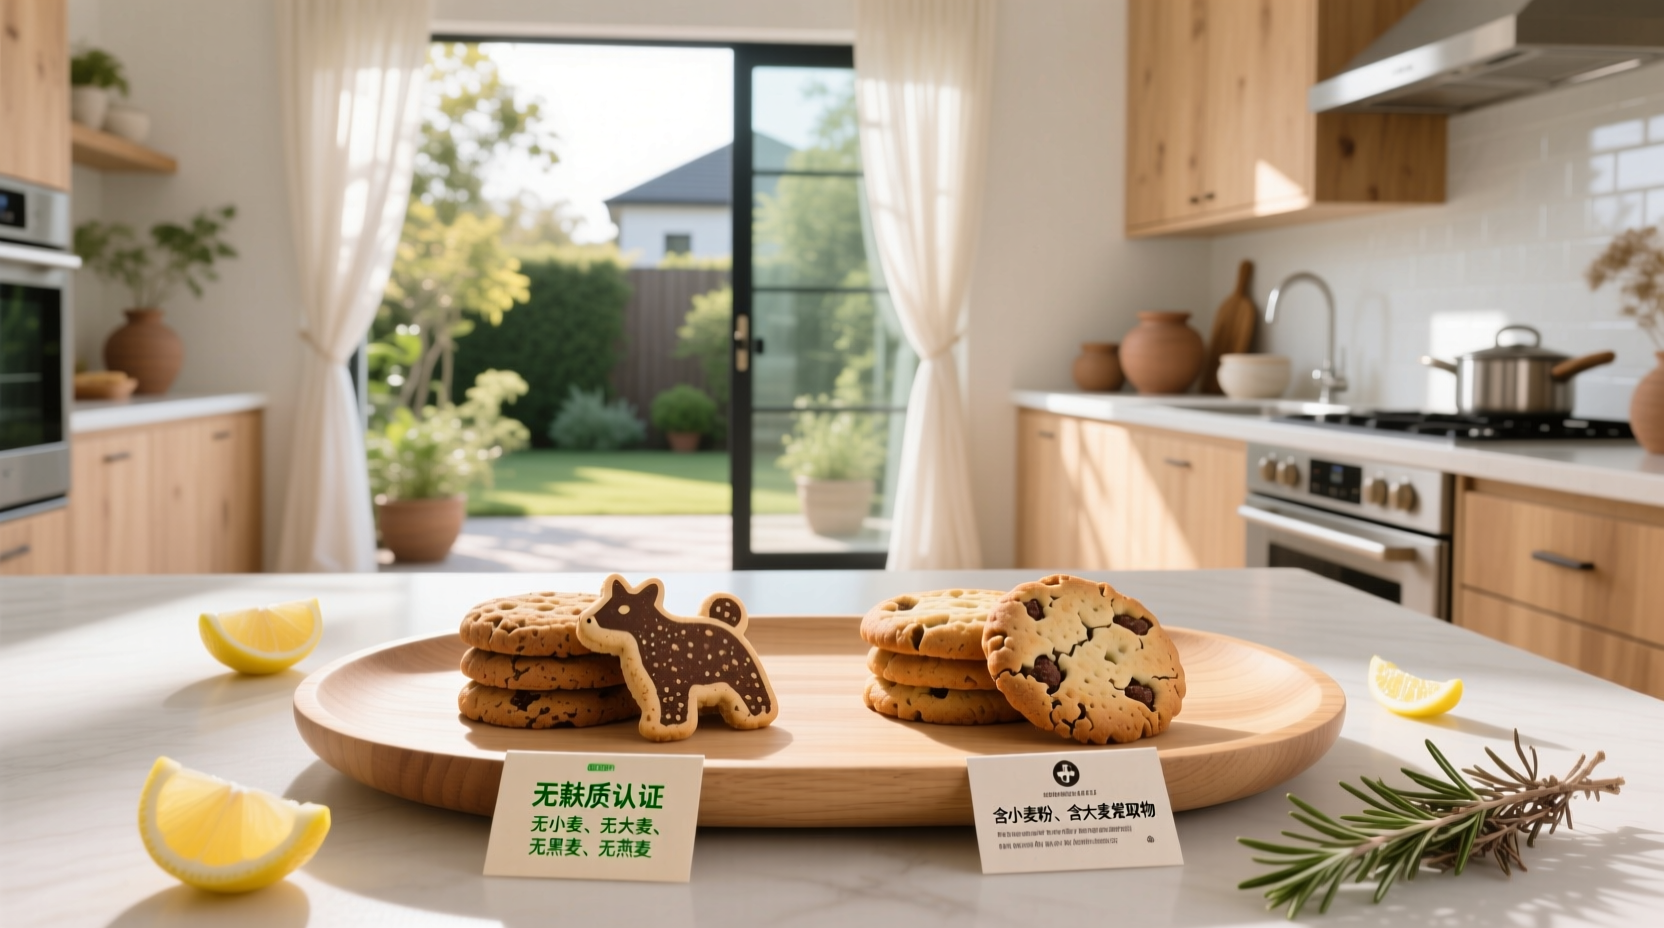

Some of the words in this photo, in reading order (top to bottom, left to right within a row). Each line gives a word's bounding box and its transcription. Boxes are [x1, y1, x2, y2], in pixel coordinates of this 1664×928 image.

[530, 815, 661, 836] 无小麦、无大麦、
[528, 837, 652, 859] 无黑麦、无燕麦
